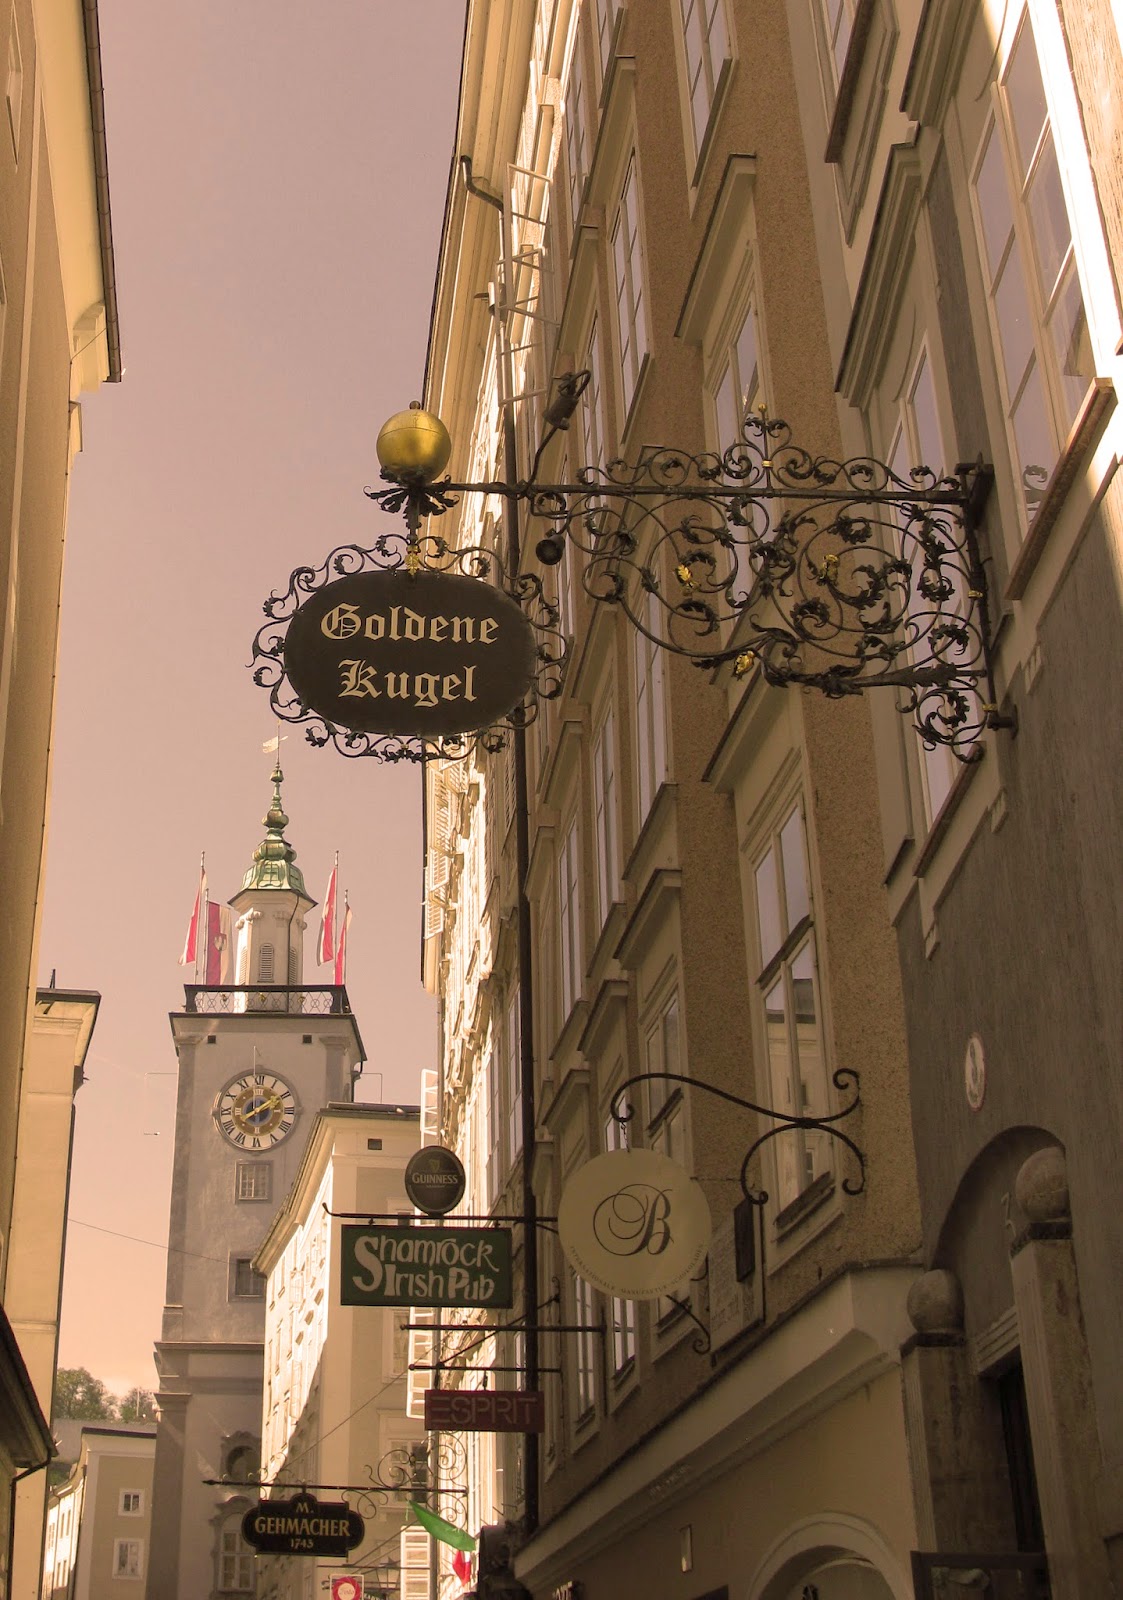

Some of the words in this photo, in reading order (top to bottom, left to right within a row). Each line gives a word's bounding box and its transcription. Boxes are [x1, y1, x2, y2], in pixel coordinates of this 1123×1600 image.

[320, 603, 499, 644] Goldene
[338, 659, 477, 708] Kugel
[411, 1172, 458, 1184] GUINNESS
[352, 1235, 500, 1292] Shamrock
[384, 1263, 444, 1298] Irish
[448, 1267, 495, 1300] Pub
[431, 1396, 538, 1425] ESPRIT
[295, 1502, 315, 1514] M.
[254, 1516, 351, 1537] GEHMACHER
